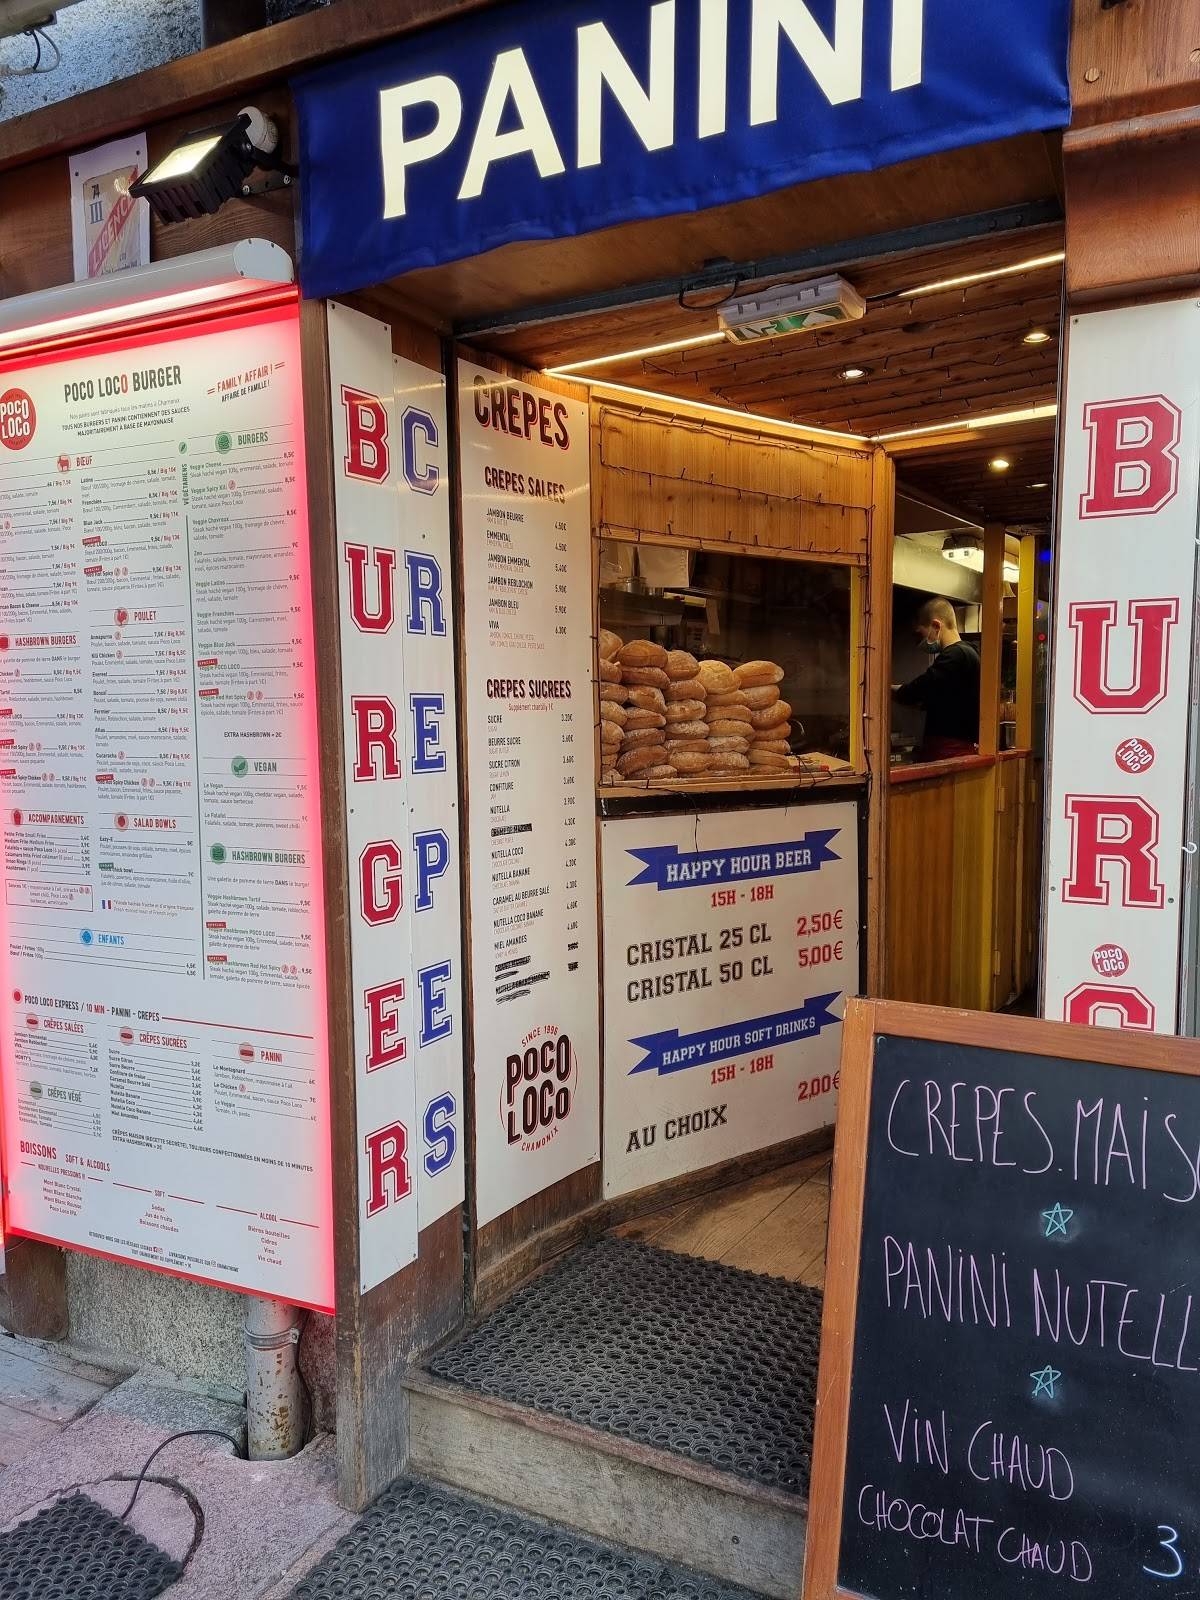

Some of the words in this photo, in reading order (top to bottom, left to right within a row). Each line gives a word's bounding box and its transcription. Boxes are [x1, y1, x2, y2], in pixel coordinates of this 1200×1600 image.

[380, 0, 924, 219] PANINI
[64, 379, 95, 404] POCO
[98, 373, 129, 399] LOCO
[132, 364, 183, 393] BURGER
[217, 374, 244, 393] FAMILY
[244, 365, 269, 384] AFFAIR
[221, 389, 240, 404] AFFAIRE
[240, 387, 248, 397] DE
[0, 398, 30, 424] POCO
[74, 421, 84, 430] NOS
[83, 418, 105, 428] BURGERS
[105, 418, 112, 426] ET
[128, 410, 160, 422] CONTIENNENT
[160, 408, 171, 417] DES
[171, 405, 191, 415] SAUCES
[473, 373, 571, 451] CREPES
[1, 416, 31, 440] LOCO
[136, 421, 143, 430] DE
[143, 416, 174, 428] MAYONNAISE
[237, 431, 269, 446] BURGERS
[484, 466, 525, 496] CREPES
[486, 508, 506, 520] JAMBON
[506, 511, 524, 523] BEURRE
[486, 530, 511, 543] EMMENTAL
[487, 553, 507, 565] JAMBON
[507, 556, 531, 568] EMMENTAL
[488, 576, 507, 587] JAMBON
[507, 578, 533, 590] REBLOCHON
[488, 598, 508, 608] JAMBON
[508, 600, 519, 610] BLEU
[134, 610, 157, 622] POULET
[488, 620, 499, 629] VIVA
[15, 634, 50, 648] HASHBROWN
[50, 633, 77, 646] BURGERS
[486, 678, 526, 699] CREPES
[528, 680, 572, 699] SUCREES
[487, 714, 503, 723] SUCRE
[224, 731, 240, 739] EXTRA
[240, 731, 271, 739] HASHBROWN
[488, 738, 506, 747] BEURRE
[506, 736, 521, 745] SUCRE
[1117, 747, 1141, 772] LOCO
[1124, 738, 1153, 765] POCO
[253, 761, 278, 773] VEGAN
[488, 760, 504, 769] SUCRE
[504, 759, 521, 768] CITRON
[402, 405, 457, 1178] CREPES
[489, 781, 514, 792] CONFITURE
[341, 383, 410, 1219] BURGER
[489, 804, 510, 815] NUTELLA
[28, 813, 85, 826] ACCOMPAGNEMENTS
[133, 817, 154, 829] SALAD
[154, 819, 177, 830] BOWLS
[231, 850, 273, 863] HASHBROWN
[274, 852, 306, 865] BURGERS
[491, 848, 511, 860] NUTELLA
[512, 846, 524, 856] COCO
[491, 871, 512, 882] NUTELLA
[512, 867, 531, 878] BANANE
[666, 859, 726, 883] HAPPY
[730, 854, 771, 876] HOUR
[775, 848, 812, 869] BEER
[492, 893, 515, 906] CARAMEL
[515, 892, 521, 900] AU
[521, 888, 539, 899] BEURRE
[710, 888, 737, 908] 15H
[749, 883, 775, 903] 18H
[493, 916, 514, 928] NUTELLA
[514, 913, 526, 923] COCO
[526, 908, 544, 920] BANANE
[796, 908, 845, 938] 2,50€
[98, 933, 125, 946] ENFANTS
[505, 934, 528, 948] AMANDES
[625, 931, 713, 968] CRISTAL
[719, 925, 744, 951] 25
[749, 921, 772, 944] CL
[796, 939, 845, 970] 5,00€
[1093, 947, 1123, 964] POCO
[1096, 958, 1126, 973] LOCO
[626, 966, 713, 1004] CRISTAL
[719, 958, 744, 984] 50
[749, 953, 774, 978] CL
[24, 994, 39, 1006] POCO
[39, 997, 54, 1008] LOCO
[54, 999, 80, 1011] EXPRESS
[85, 1003, 93, 1013] 10
[93, 1003, 105, 1015] MIN
[111, 1006, 131, 1018] PANINI
[137, 1009, 161, 1022] CREPES
[521, 1027, 542, 1048] SINCE
[661, 1041, 707, 1066] HAPPY
[708, 1034, 741, 1056] HOUR
[744, 1025, 773, 1047] SOFT
[775, 1014, 818, 1040] DRINKS
[260, 1050, 283, 1063] PANINI
[506, 1034, 572, 1107] POCO
[710, 1065, 737, 1086] 15H
[748, 1053, 774, 1076] 18H
[507, 1078, 572, 1146] LOCO
[625, 1123, 657, 1155] AU
[664, 1102, 729, 1142] CHOIX
[521, 1126, 559, 1153] CHAMONIX
[20, 1140, 57, 1160] BOISSONS
[65, 1153, 79, 1166] SOFT
[86, 1158, 111, 1173] ALCOOLS
[154, 1189, 166, 1198] SOFT
[259, 1211, 278, 1223] ALCOOL
[967, 1420, 1074, 1502] CHAUD
[857, 1483, 996, 1553] CHOCOLAT
[997, 1526, 1093, 1583] CHAUD
[1141, 1525, 1183, 1578] 3
